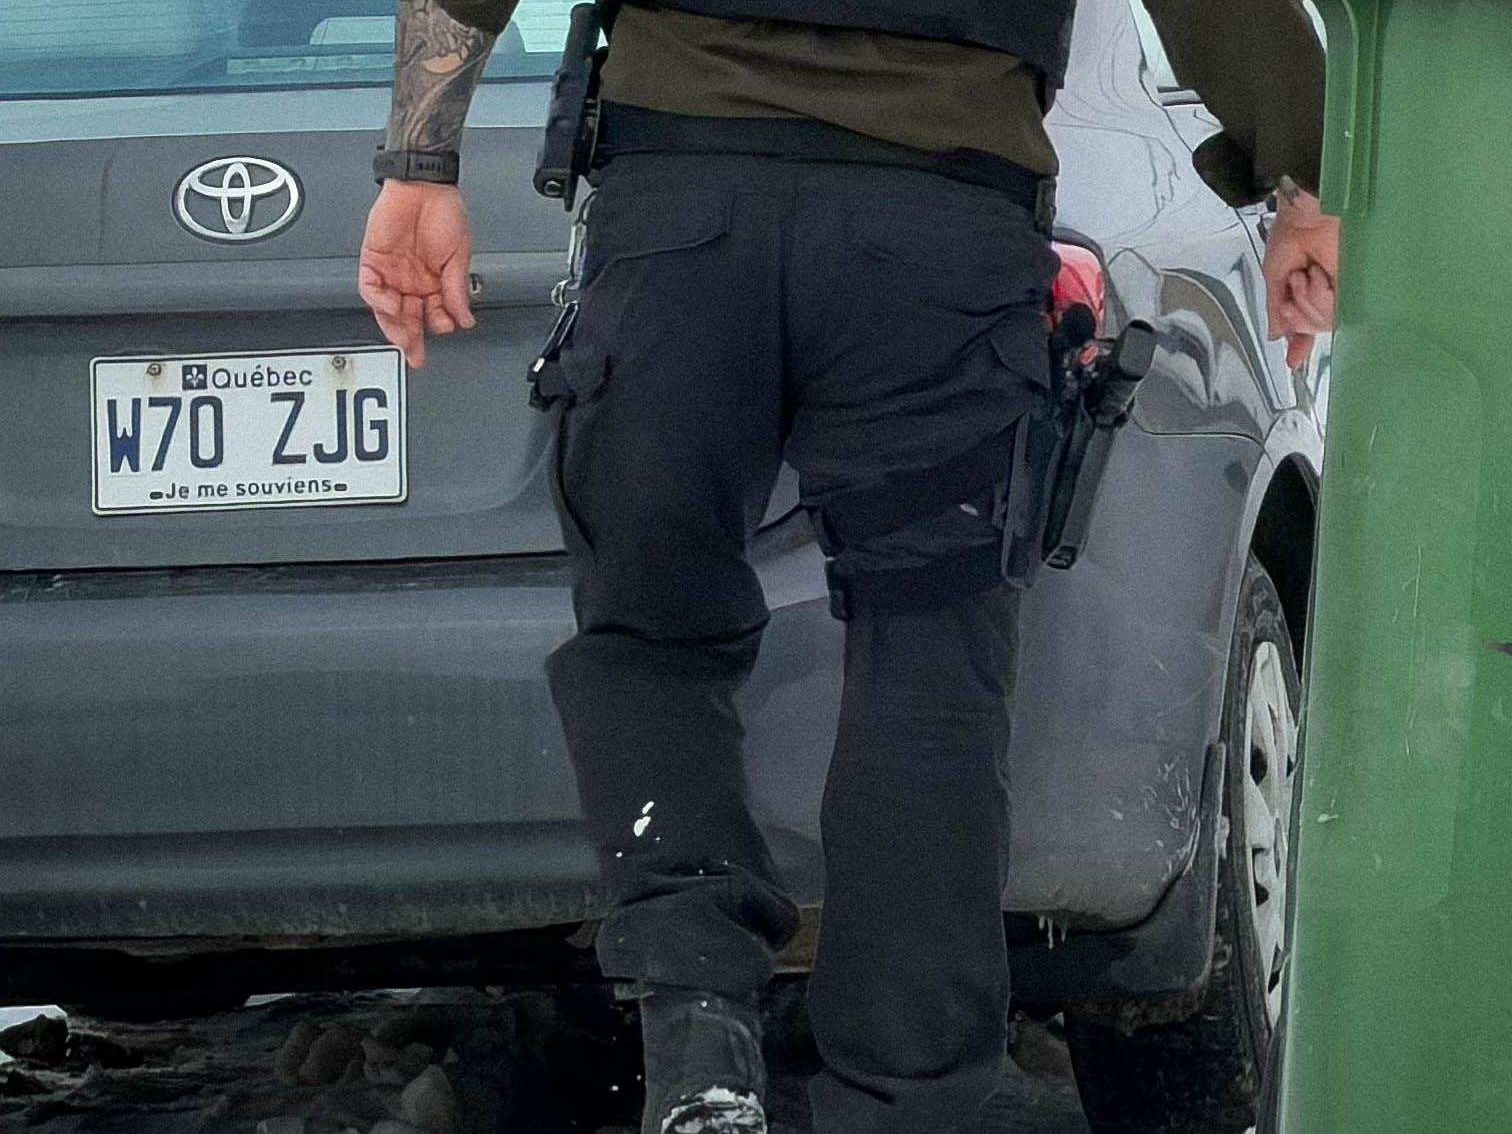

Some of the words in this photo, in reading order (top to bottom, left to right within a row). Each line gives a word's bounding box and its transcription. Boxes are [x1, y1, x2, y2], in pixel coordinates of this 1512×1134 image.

[211, 364, 313, 389] Québec
[106, 394, 224, 474] W70
[269, 387, 390, 466] ZJG
[165, 482, 190, 500] Je
[197, 484, 229, 498] me
[235, 476, 332, 497] souviens
